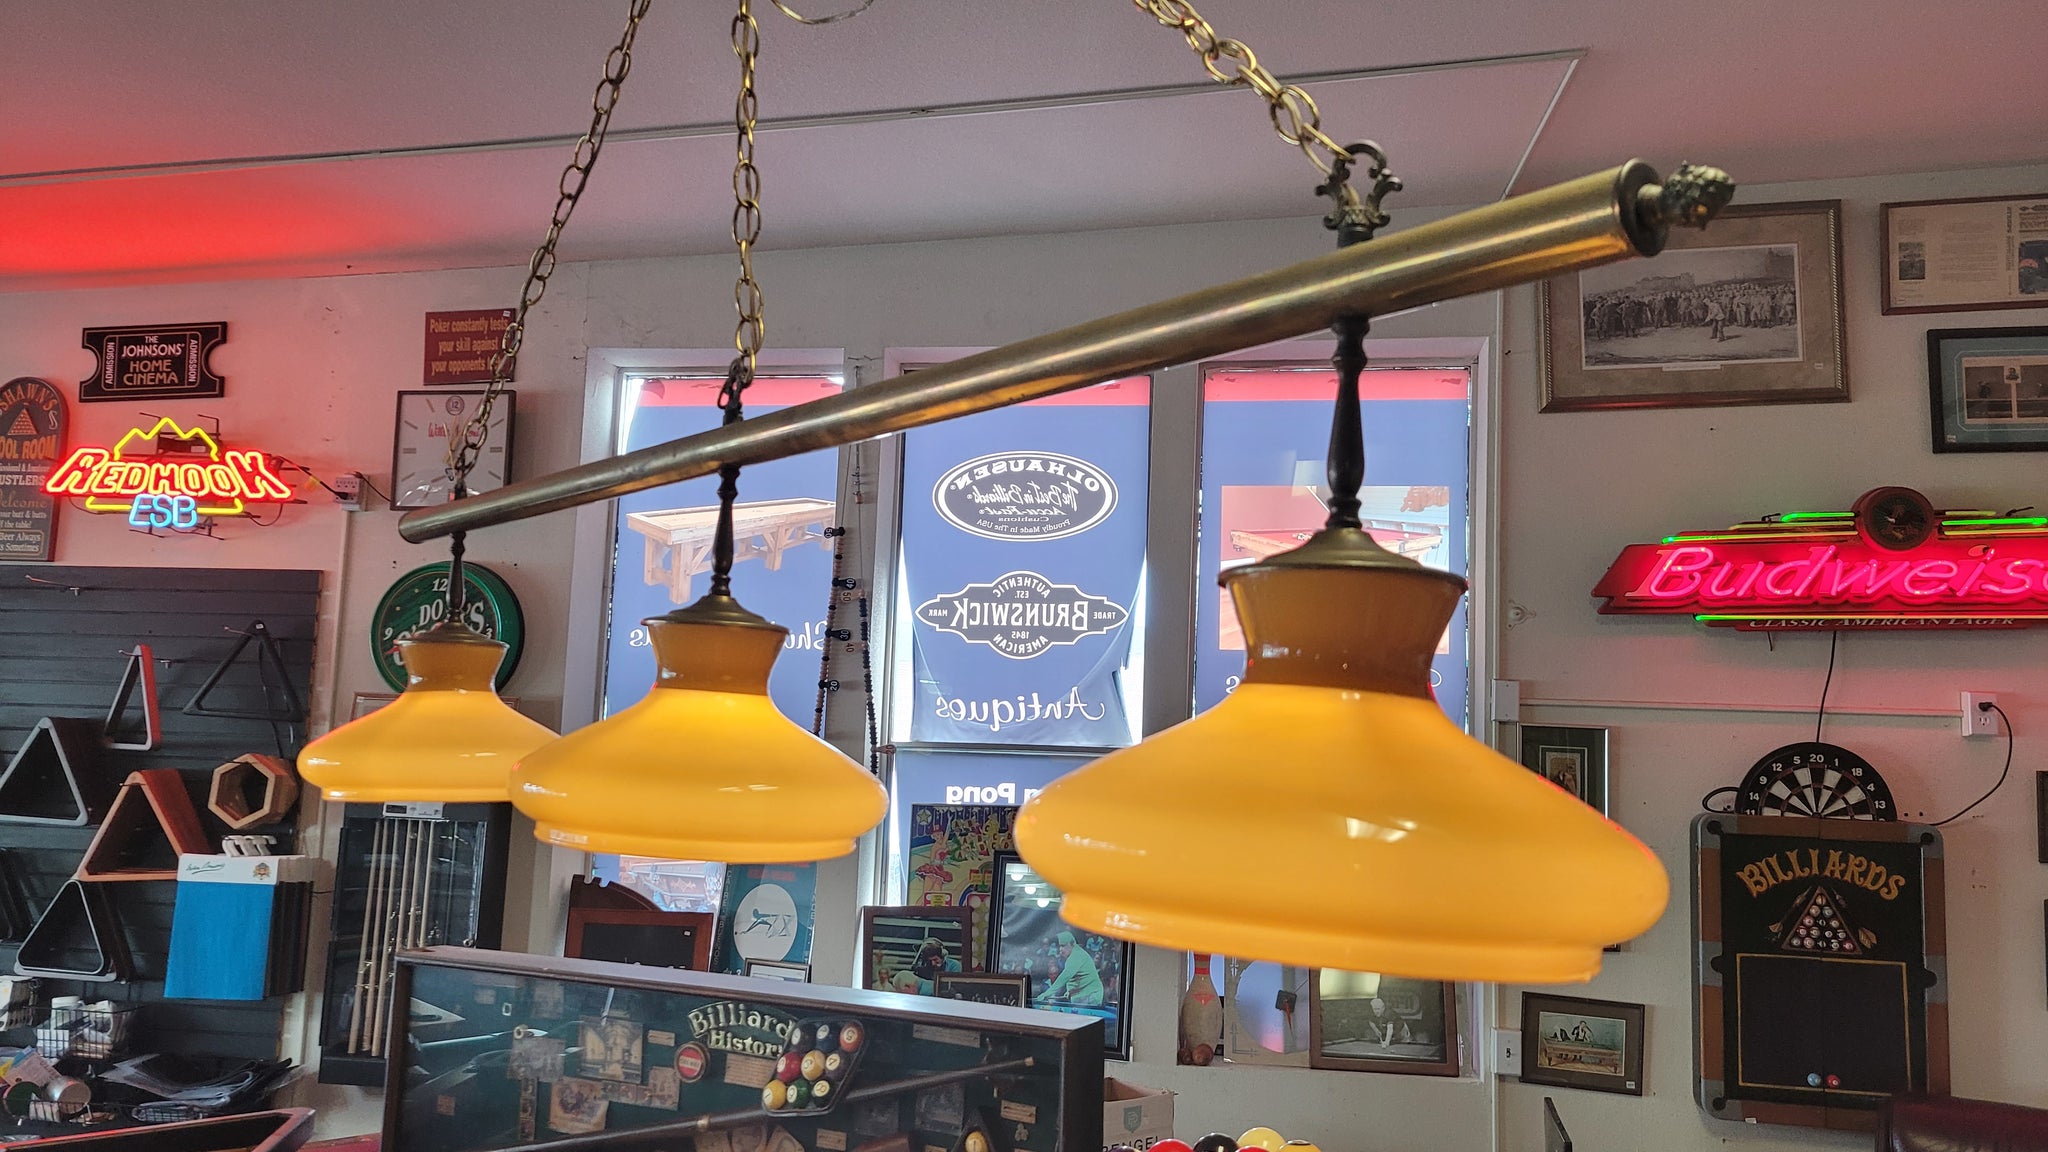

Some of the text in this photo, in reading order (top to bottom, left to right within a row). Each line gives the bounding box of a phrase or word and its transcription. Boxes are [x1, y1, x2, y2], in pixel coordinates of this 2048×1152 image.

[430, 316, 508, 334] Poker constantly tests
[144, 335, 159, 344] THE
[121, 343, 185, 357] JOHNSONS'
[438, 336, 499, 356] your skill against
[105, 342, 115, 385] ADMISSION
[130, 359, 172, 372] HOME
[188, 339, 198, 382] ADMISSION
[431, 361, 447, 376] your
[123, 372, 178, 386] CINEMA
[451, 400, 459, 409] 12
[0, 434, 57, 460] OOL ROOM
[46, 448, 292, 498] REDHOOK
[0, 474, 46, 486] USTLERS
[128, 493, 198, 528] ESB
[1624, 545, 2048, 603] Budweis
[432, 578, 448, 592] 12
[845, 578, 855, 589] 40
[842, 591, 852, 602] 50
[1749, 617, 2014, 628] CLASSIC AMERICAN LAGER
[383, 627, 393, 641] 9
[485, 627, 493, 640] 3
[839, 629, 850, 640] 30
[846, 642, 855, 653] 40
[830, 681, 838, 691] 20
[1793, 756, 1801, 765] 5
[1809, 754, 1825, 763] 20
[1833, 758, 1839, 767] 1
[1771, 763, 1783, 772] 12
[1851, 767, 1863, 777] 18
[1759, 775, 1768, 785] 9
[1866, 783, 1875, 792] 4
[1749, 792, 1760, 801] 14
[1874, 800, 1886, 809] 13
[1735, 848, 1906, 901] BILLIARDS
[688, 1003, 797, 1039] Billiard
[828, 1057, 837, 1066] 7
